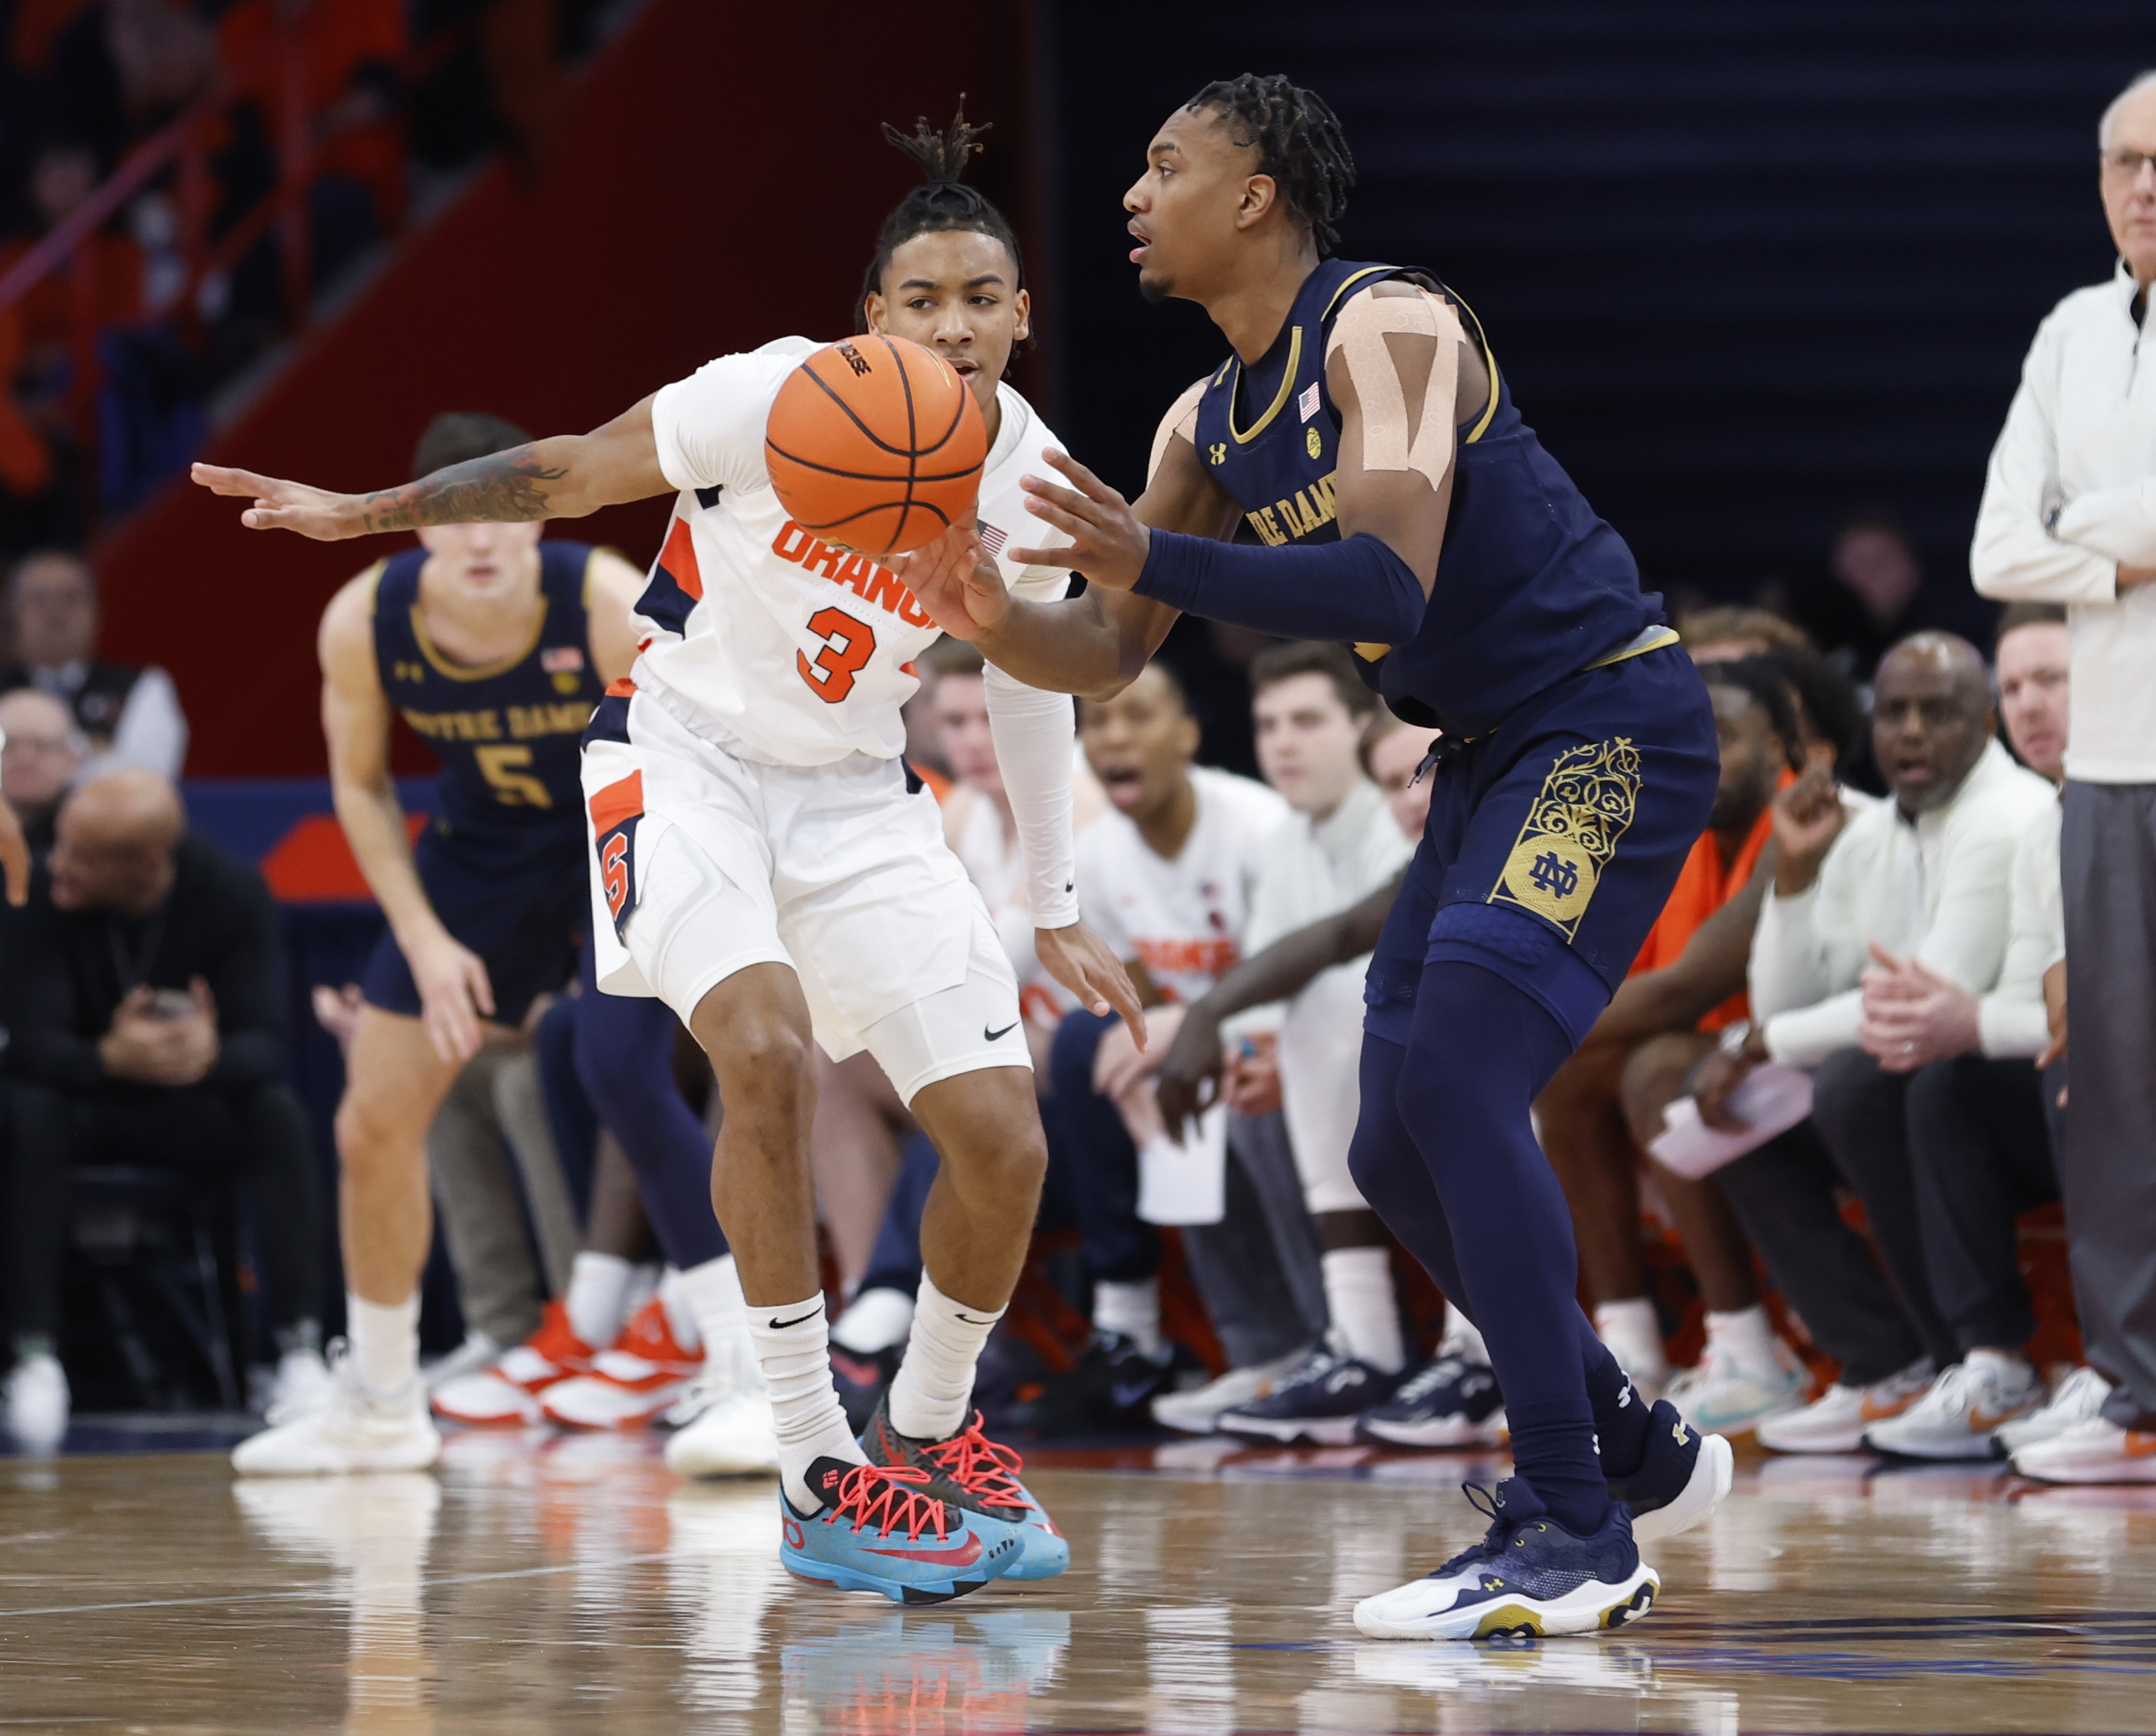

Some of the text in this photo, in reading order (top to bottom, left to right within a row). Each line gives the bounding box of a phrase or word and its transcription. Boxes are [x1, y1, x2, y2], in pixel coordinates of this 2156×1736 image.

[771, 520, 940, 630] ORANG
[796, 606, 876, 703] 3
[473, 745, 553, 809] 5
